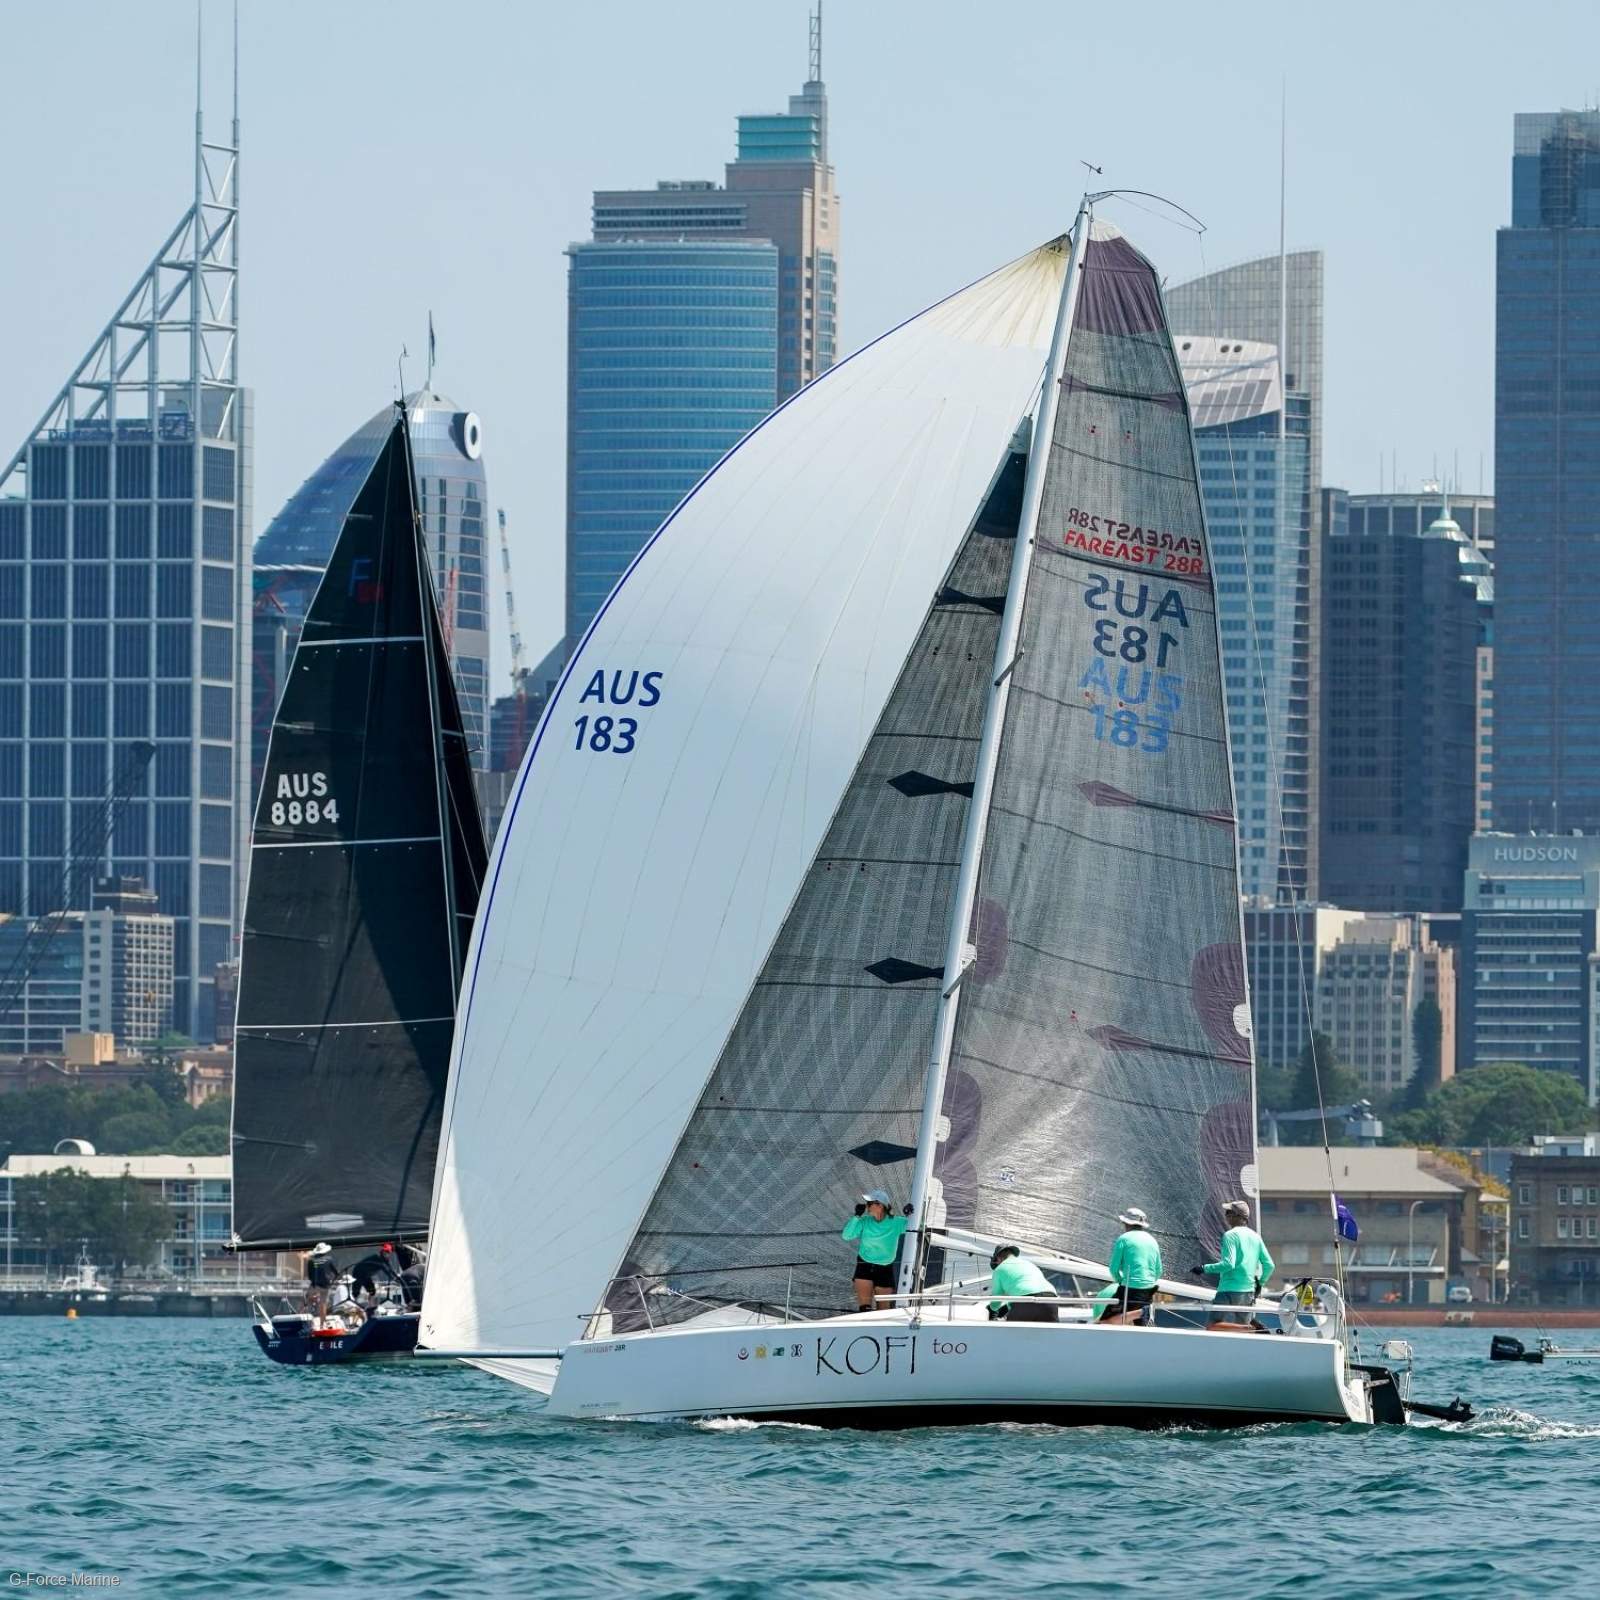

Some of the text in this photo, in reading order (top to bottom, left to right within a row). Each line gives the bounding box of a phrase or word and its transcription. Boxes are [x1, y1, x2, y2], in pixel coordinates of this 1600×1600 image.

[1063, 529, 1204, 576] FAREAST 28R
[578, 669, 664, 707] AUS
[1077, 656, 1185, 714] AUS
[574, 715, 638, 754] 183
[1088, 703, 1172, 753] 183
[277, 771, 328, 799] AUS
[271, 798, 340, 826] 8884
[1493, 847, 1578, 862] HUDSON
[319, 1340, 344, 1350] EILE
[815, 1335, 968, 1376] KOFI too
